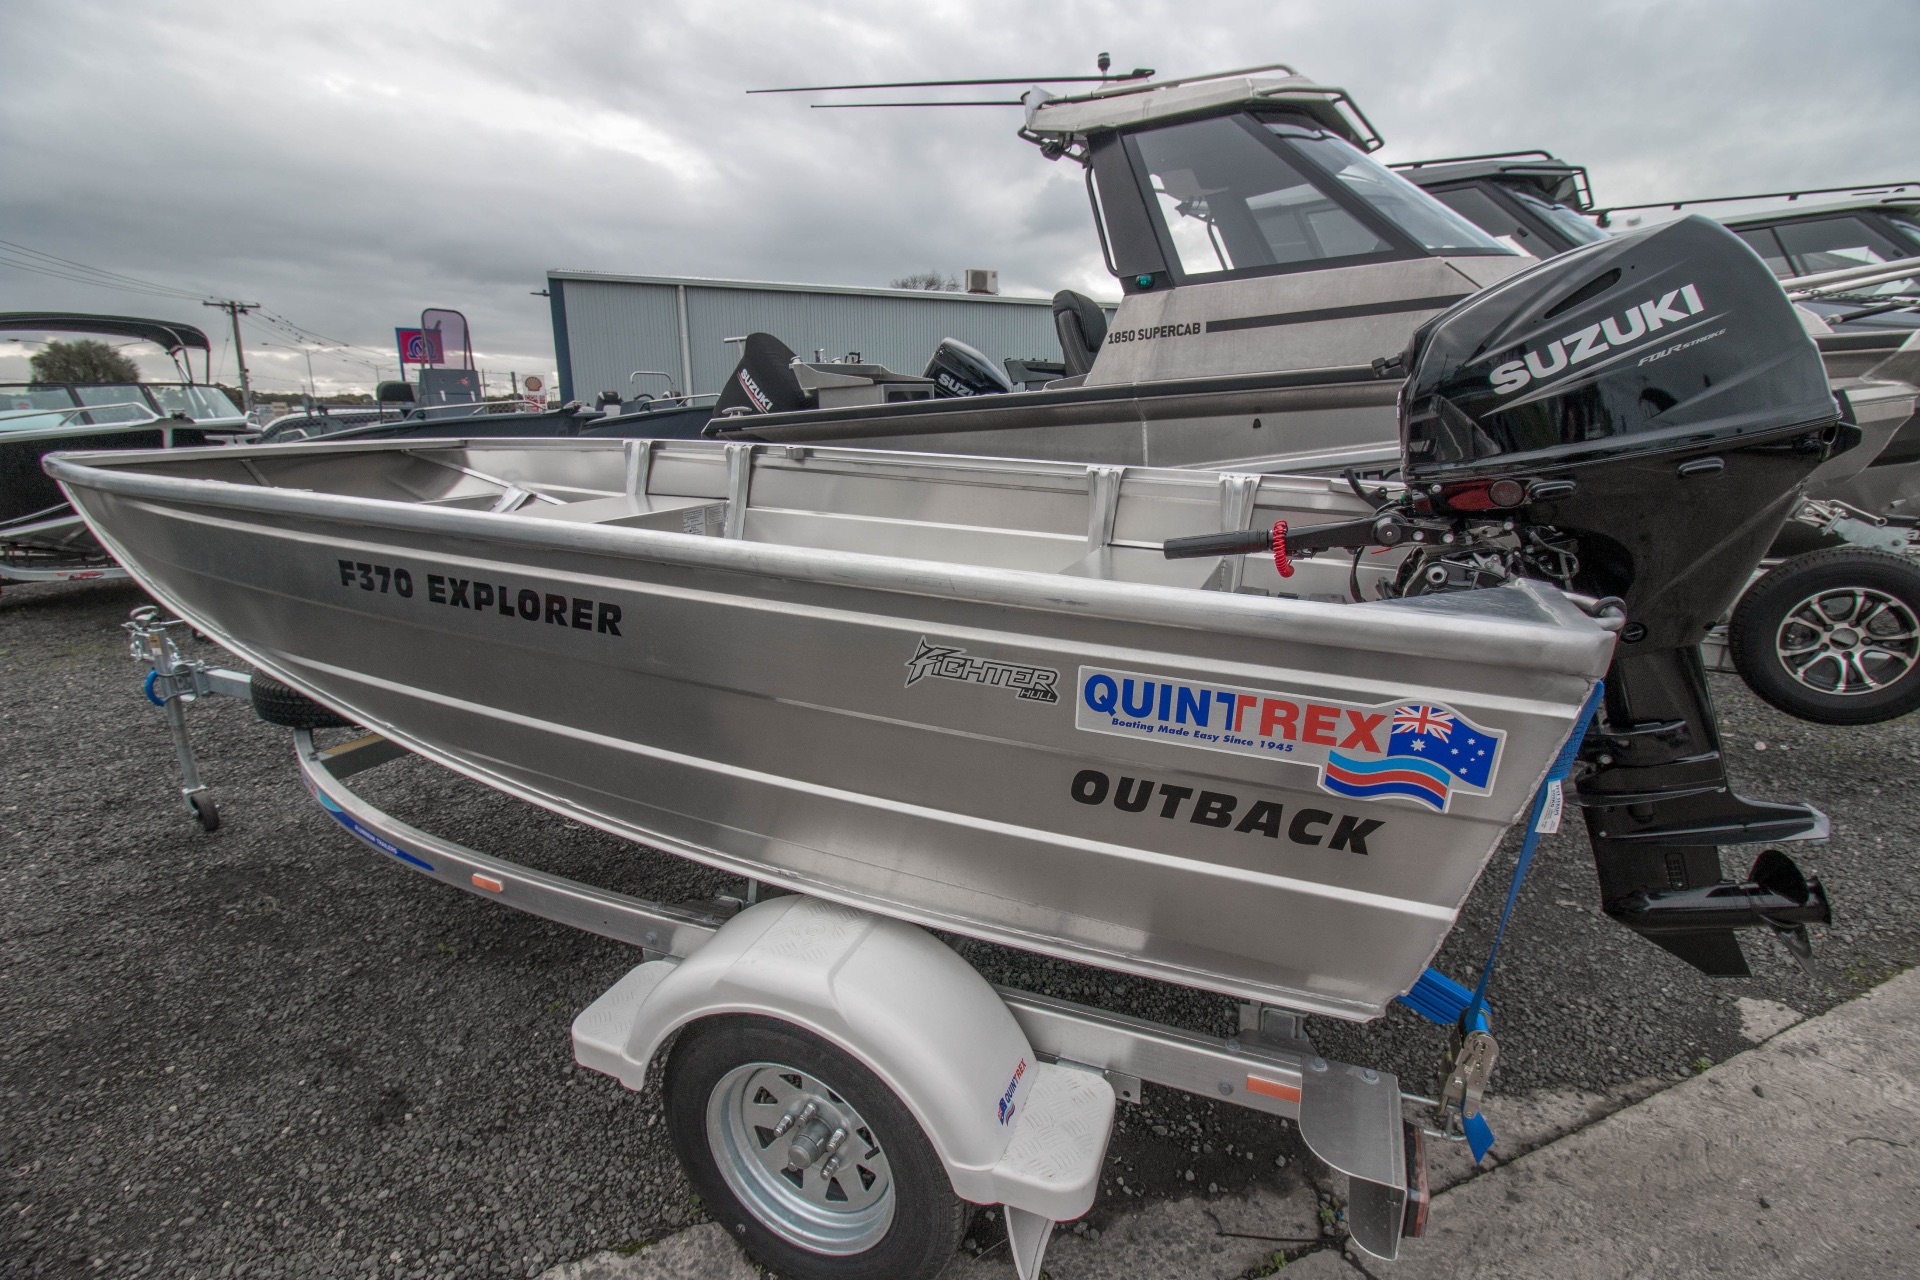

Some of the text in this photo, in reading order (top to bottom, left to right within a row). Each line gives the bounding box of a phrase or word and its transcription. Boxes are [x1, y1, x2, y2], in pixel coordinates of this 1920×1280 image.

[1108, 322, 1201, 344] 1850 SUPERCAB
[1489, 283, 1704, 394] SUZUKI
[741, 368, 773, 410] SUZUKI
[338, 560, 622, 636] F370 EXPLORER
[1020, 688, 1056, 702] HULL
[1084, 674, 1387, 754] QUINTREX
[1111, 718, 1293, 752] Boating Made Easy Since 1945
[1071, 769, 1386, 855] OUTBACK
[1004, 1057, 1027, 1103] QUINTREX
